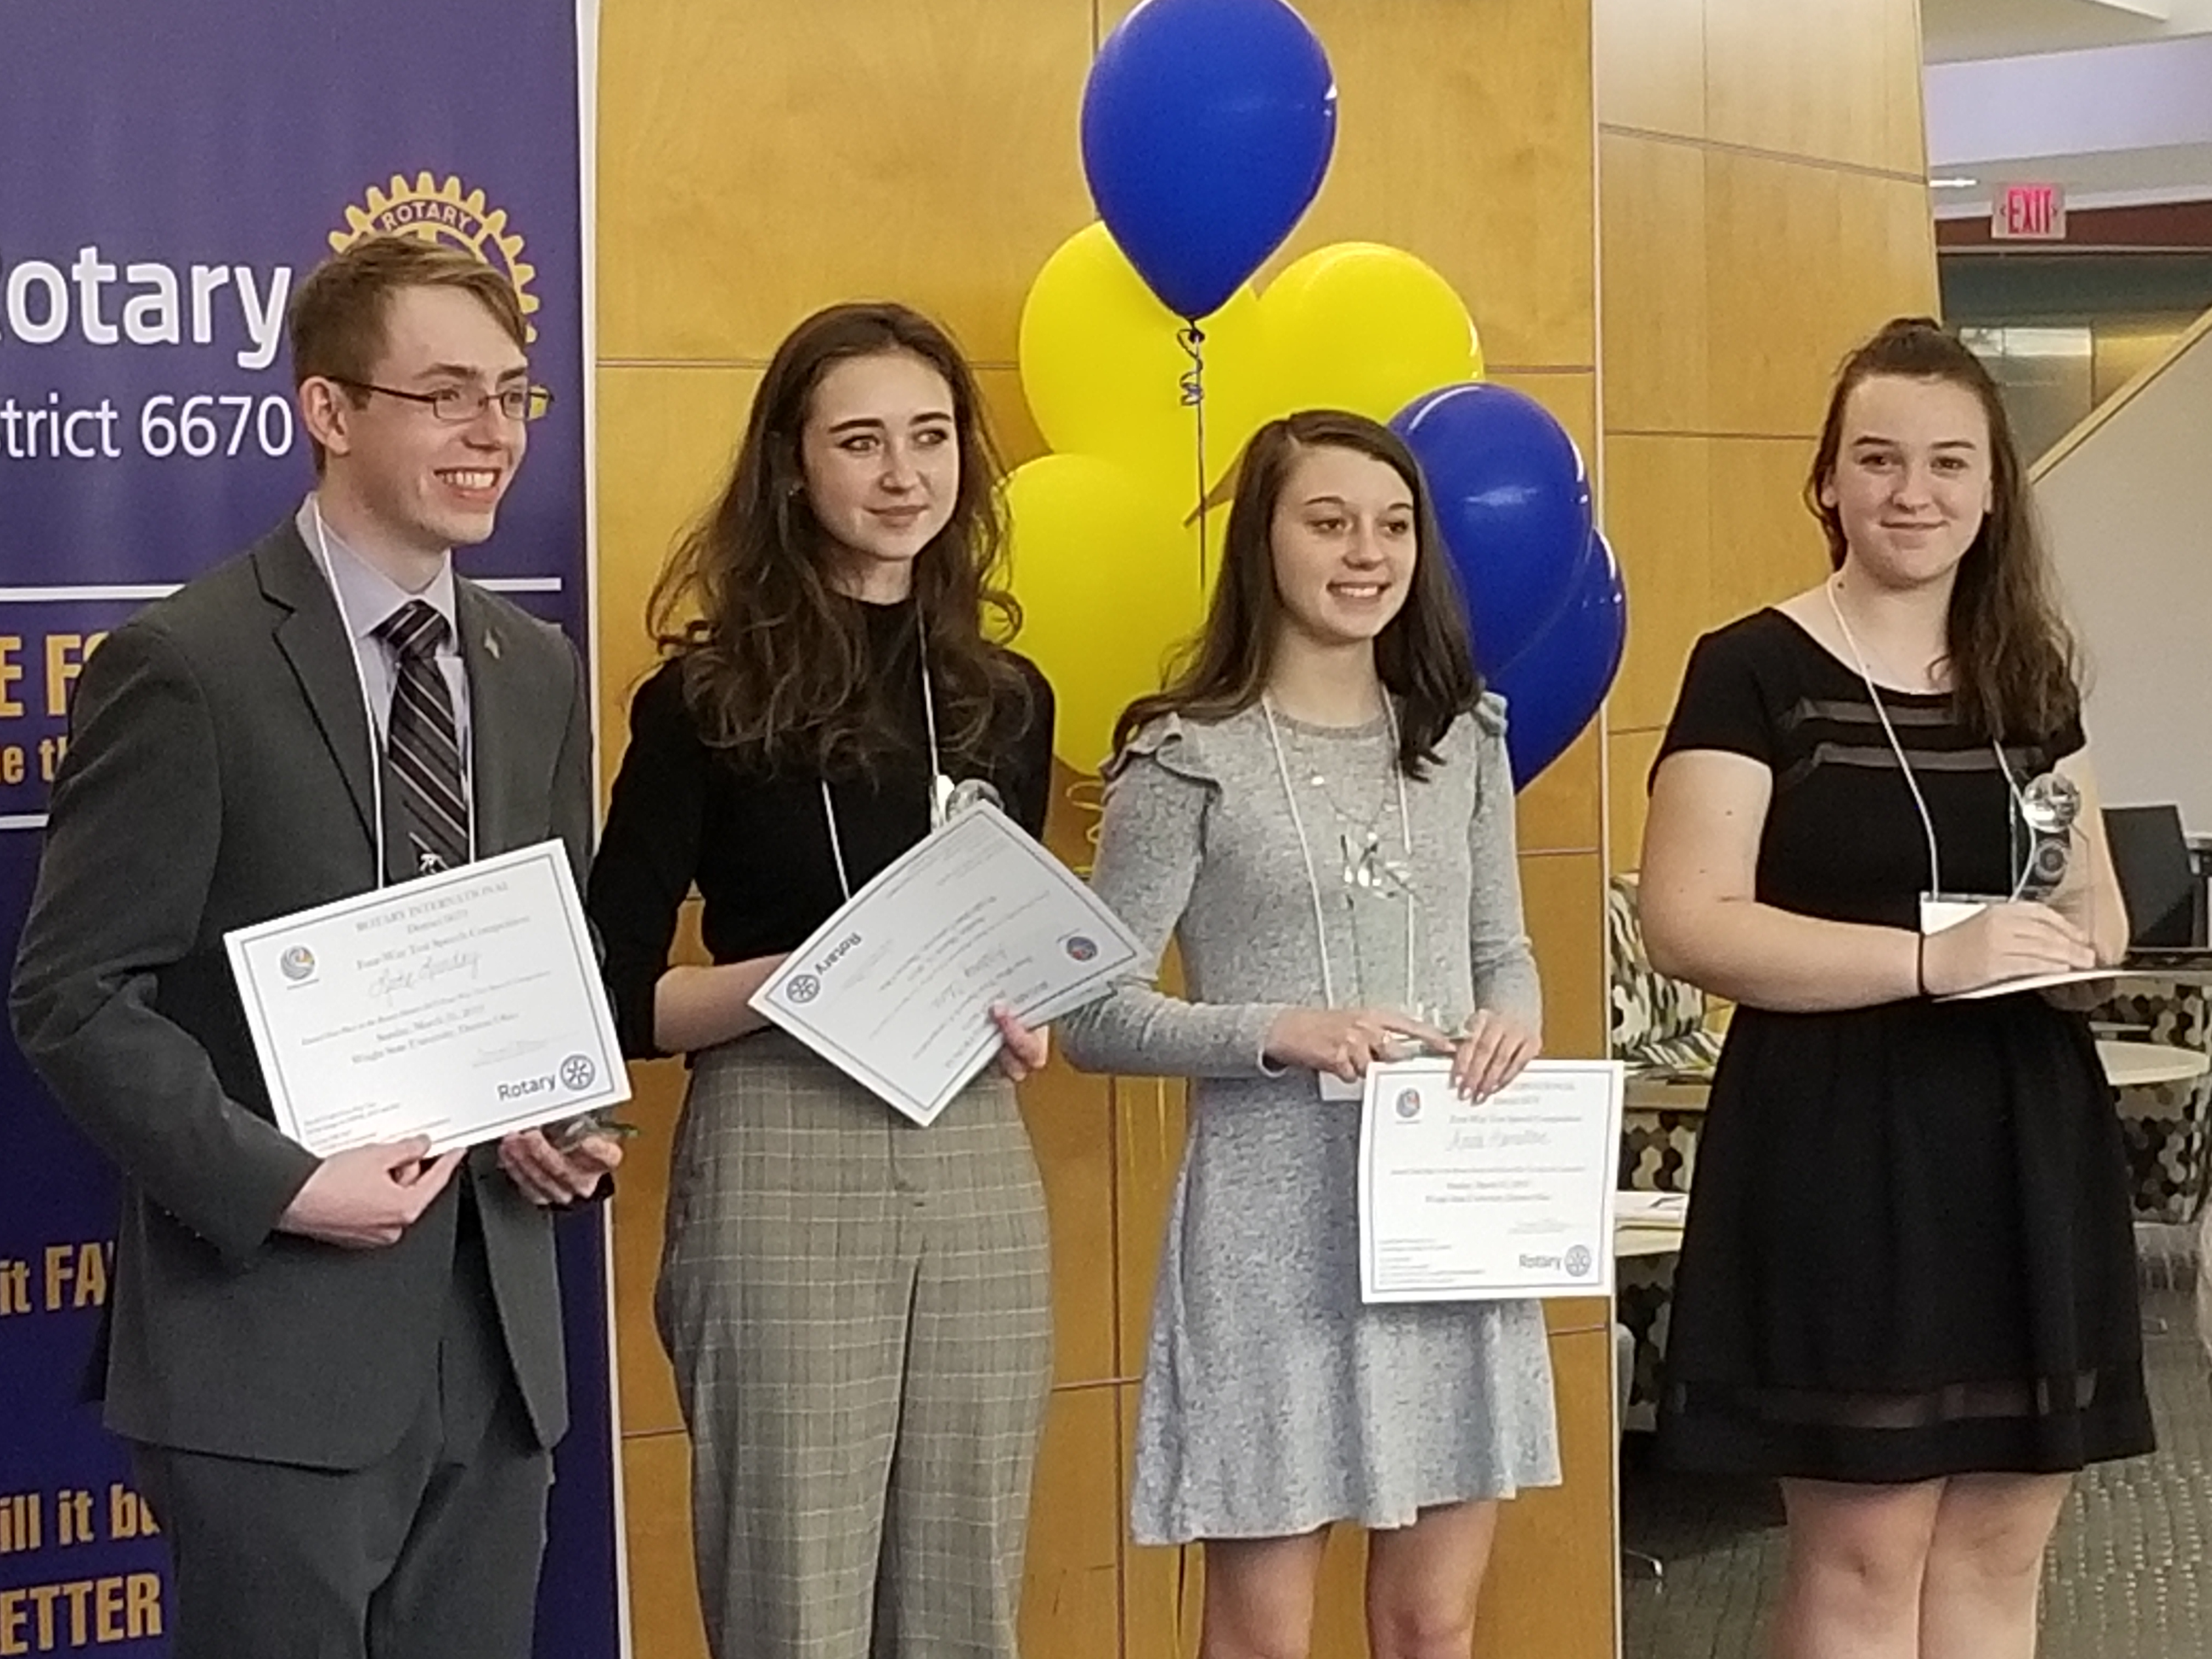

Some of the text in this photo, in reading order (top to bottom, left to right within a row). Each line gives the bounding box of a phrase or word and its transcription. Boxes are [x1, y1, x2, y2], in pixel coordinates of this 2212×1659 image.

[381, 201, 472, 232] ROTARY
[2008, 189, 2051, 234] EXIT
[0, 246, 292, 369] otary
[0, 393, 293, 458] trict 6670
[46, 631, 109, 716] F
[815, 932, 861, 975] Rotary
[497, 1074, 556, 1101] Rotary
[46, 1240, 114, 1312] FA
[1519, 1254, 1562, 1271] Rotary
[58, 1489, 94, 1545] it
